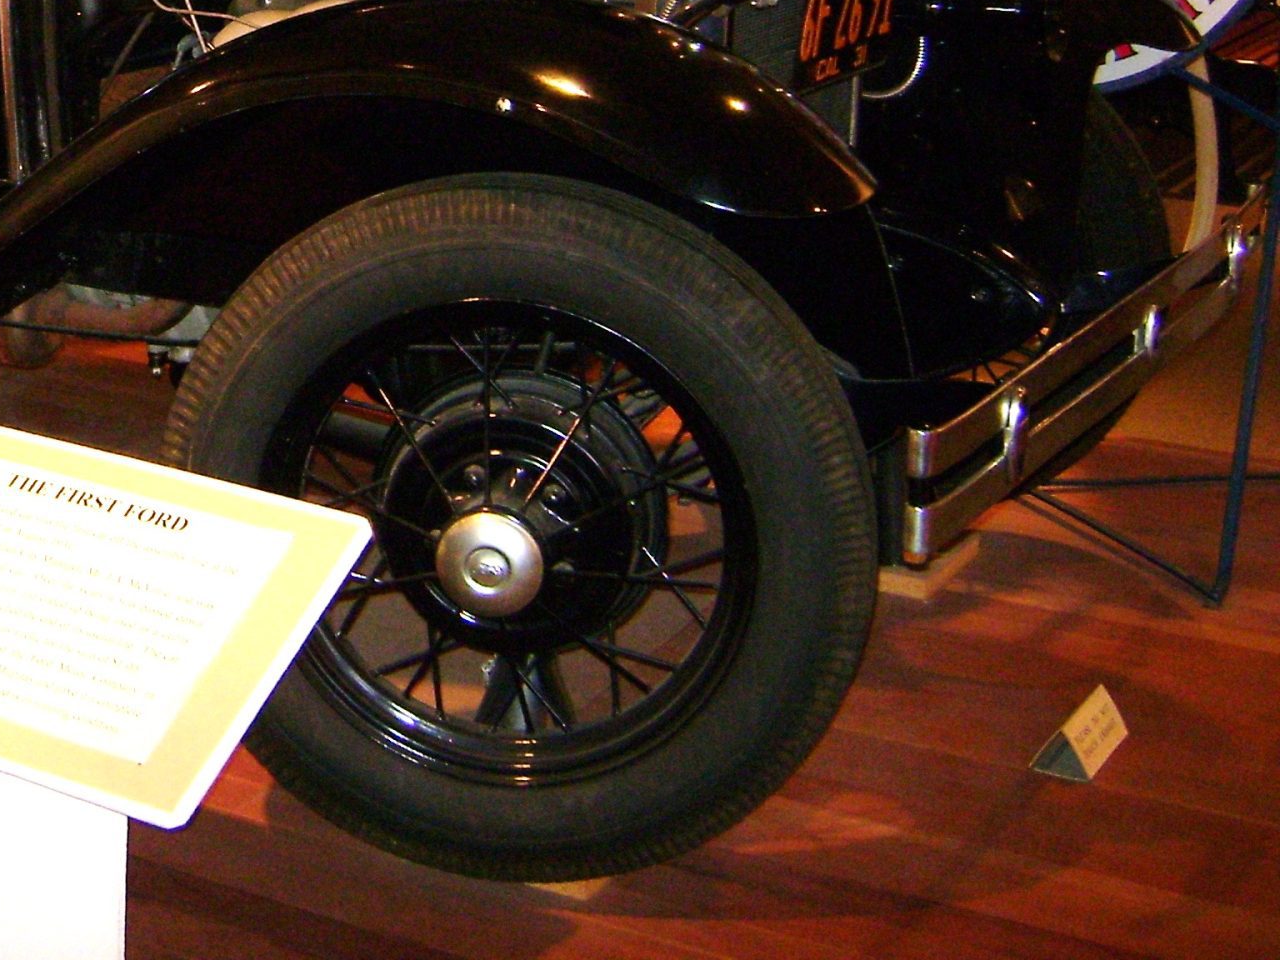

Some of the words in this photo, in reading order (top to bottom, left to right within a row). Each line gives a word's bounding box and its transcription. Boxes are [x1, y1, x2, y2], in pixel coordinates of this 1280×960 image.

[8, 473, 54, 496] THE
[55, 485, 123, 514] FIRST
[124, 503, 190, 531] FORD
